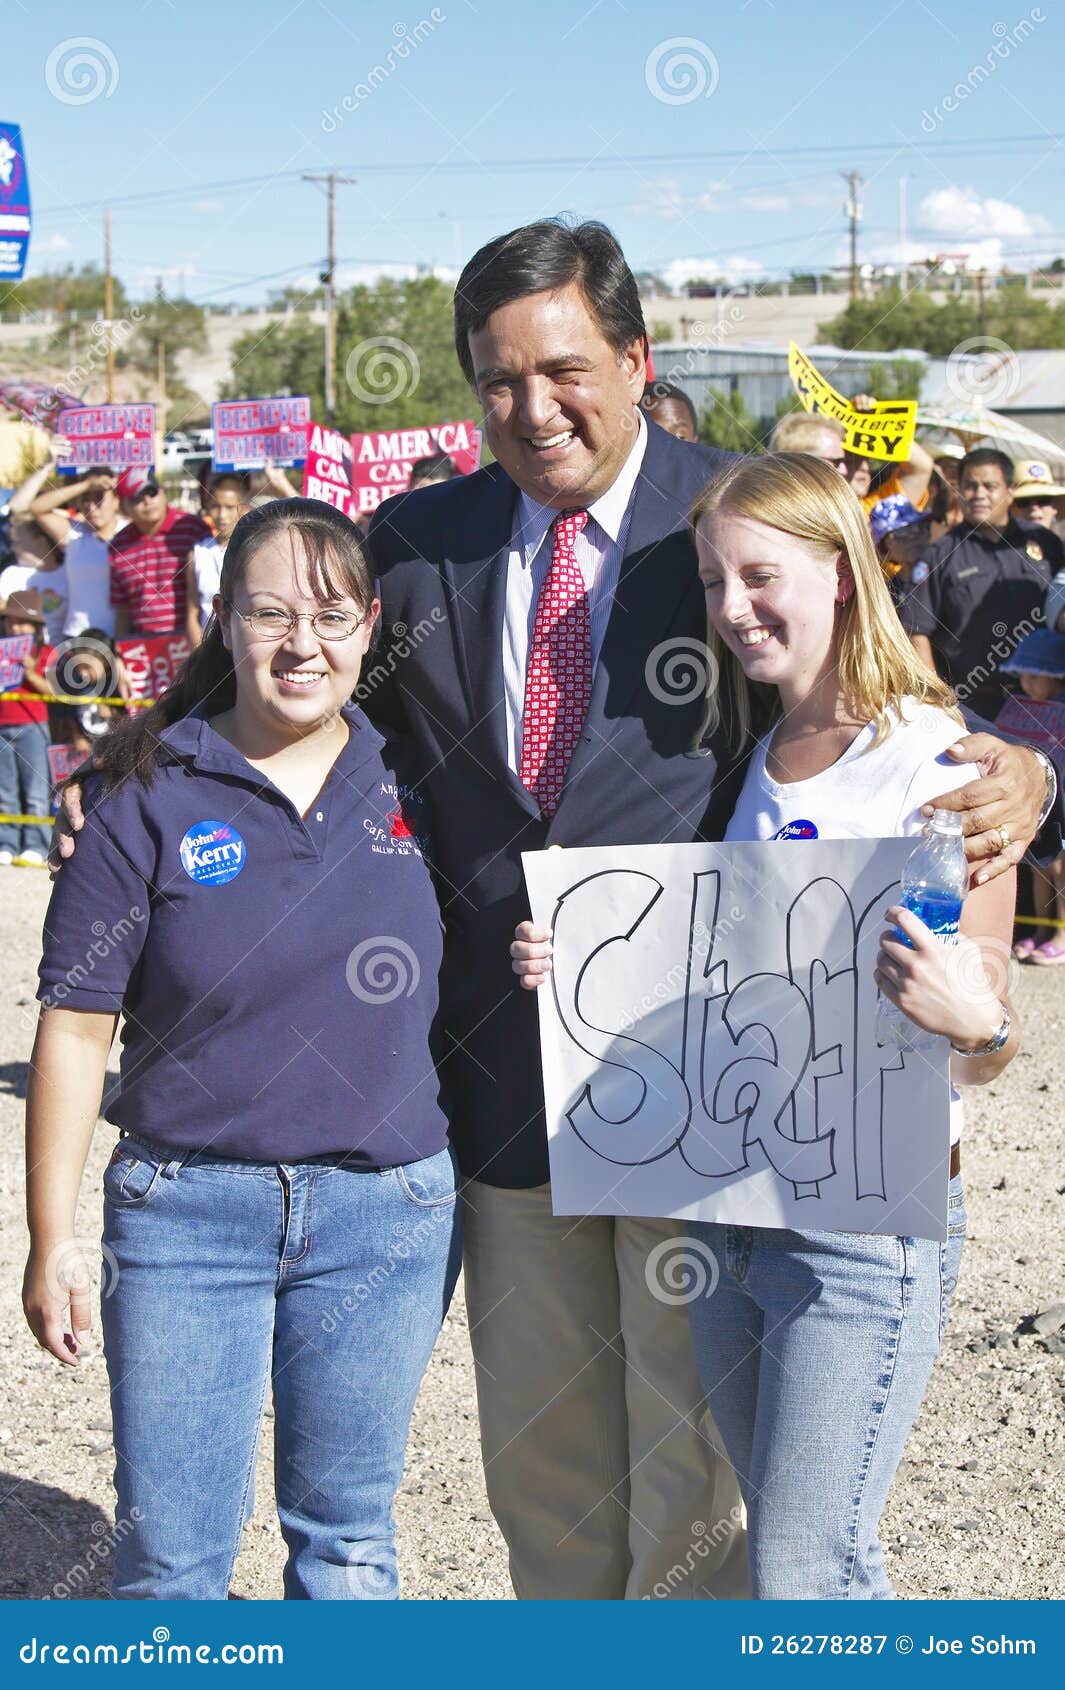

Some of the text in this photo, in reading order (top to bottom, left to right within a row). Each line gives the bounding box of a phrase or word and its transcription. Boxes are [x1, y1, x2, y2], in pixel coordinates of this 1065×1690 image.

[64, 408, 152, 433] BELIEVE
[185, 833, 215, 849] John
[184, 842, 242, 871] Kerry
